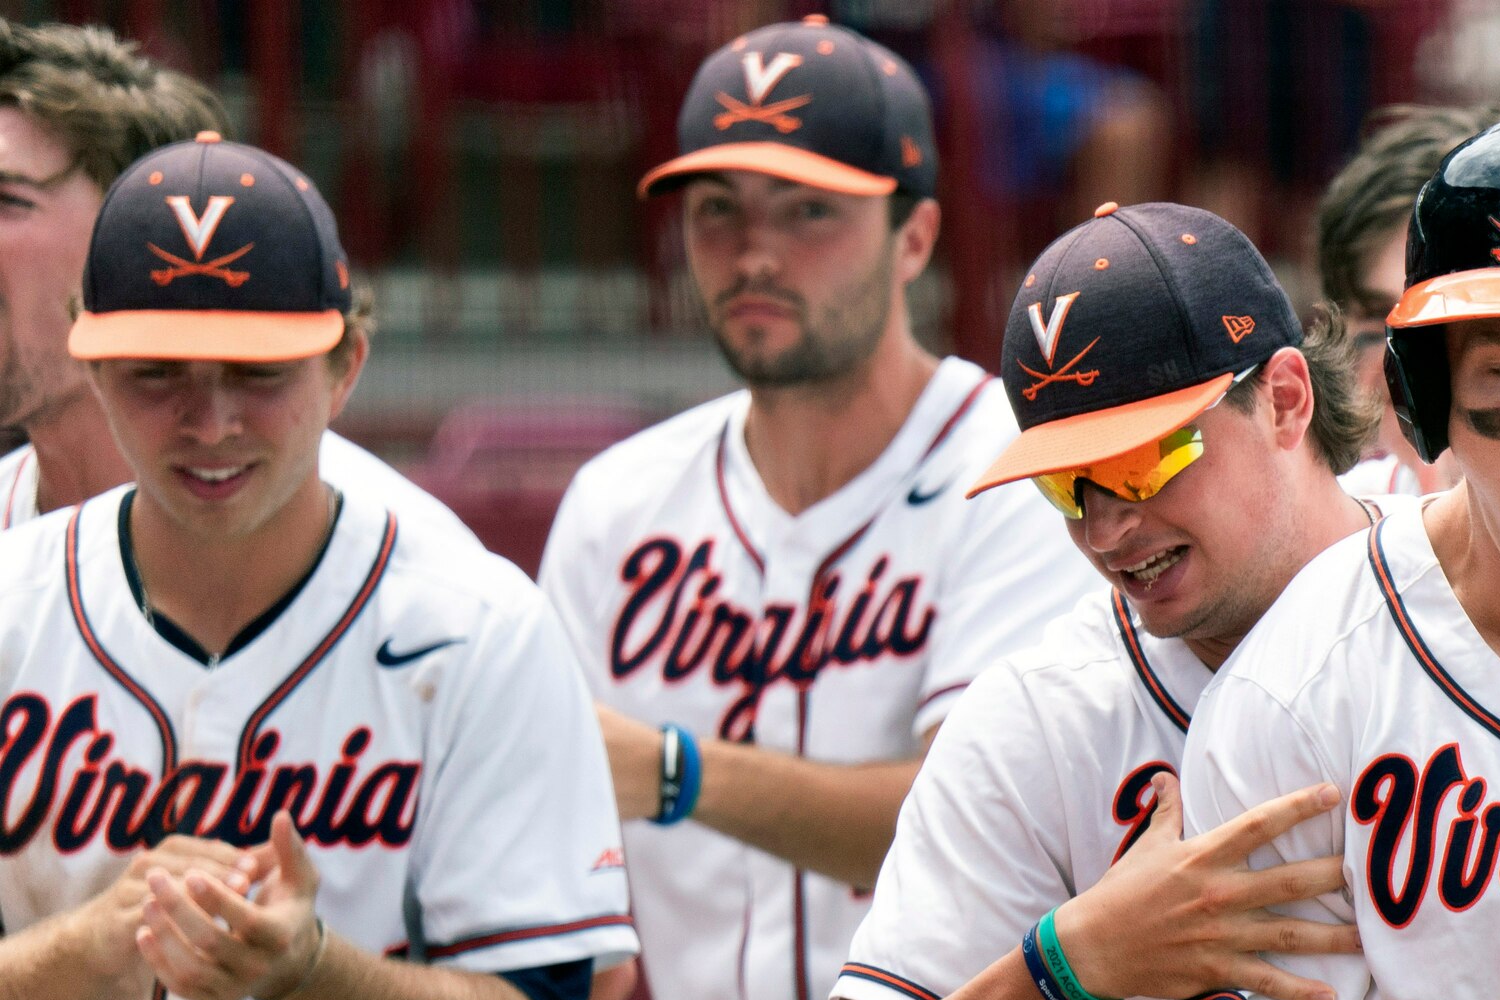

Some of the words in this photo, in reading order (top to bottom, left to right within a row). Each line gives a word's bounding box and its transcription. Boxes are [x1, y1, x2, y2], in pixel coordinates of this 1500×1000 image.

[740, 52, 802, 104] V
[166, 195, 235, 257] V
[1027, 292, 1081, 370] V
[609, 536, 937, 744] Virgiia
[0, 691, 423, 855] Virginia
[1046, 945, 1065, 974] 2021
[1060, 975, 1082, 1000] ACC
